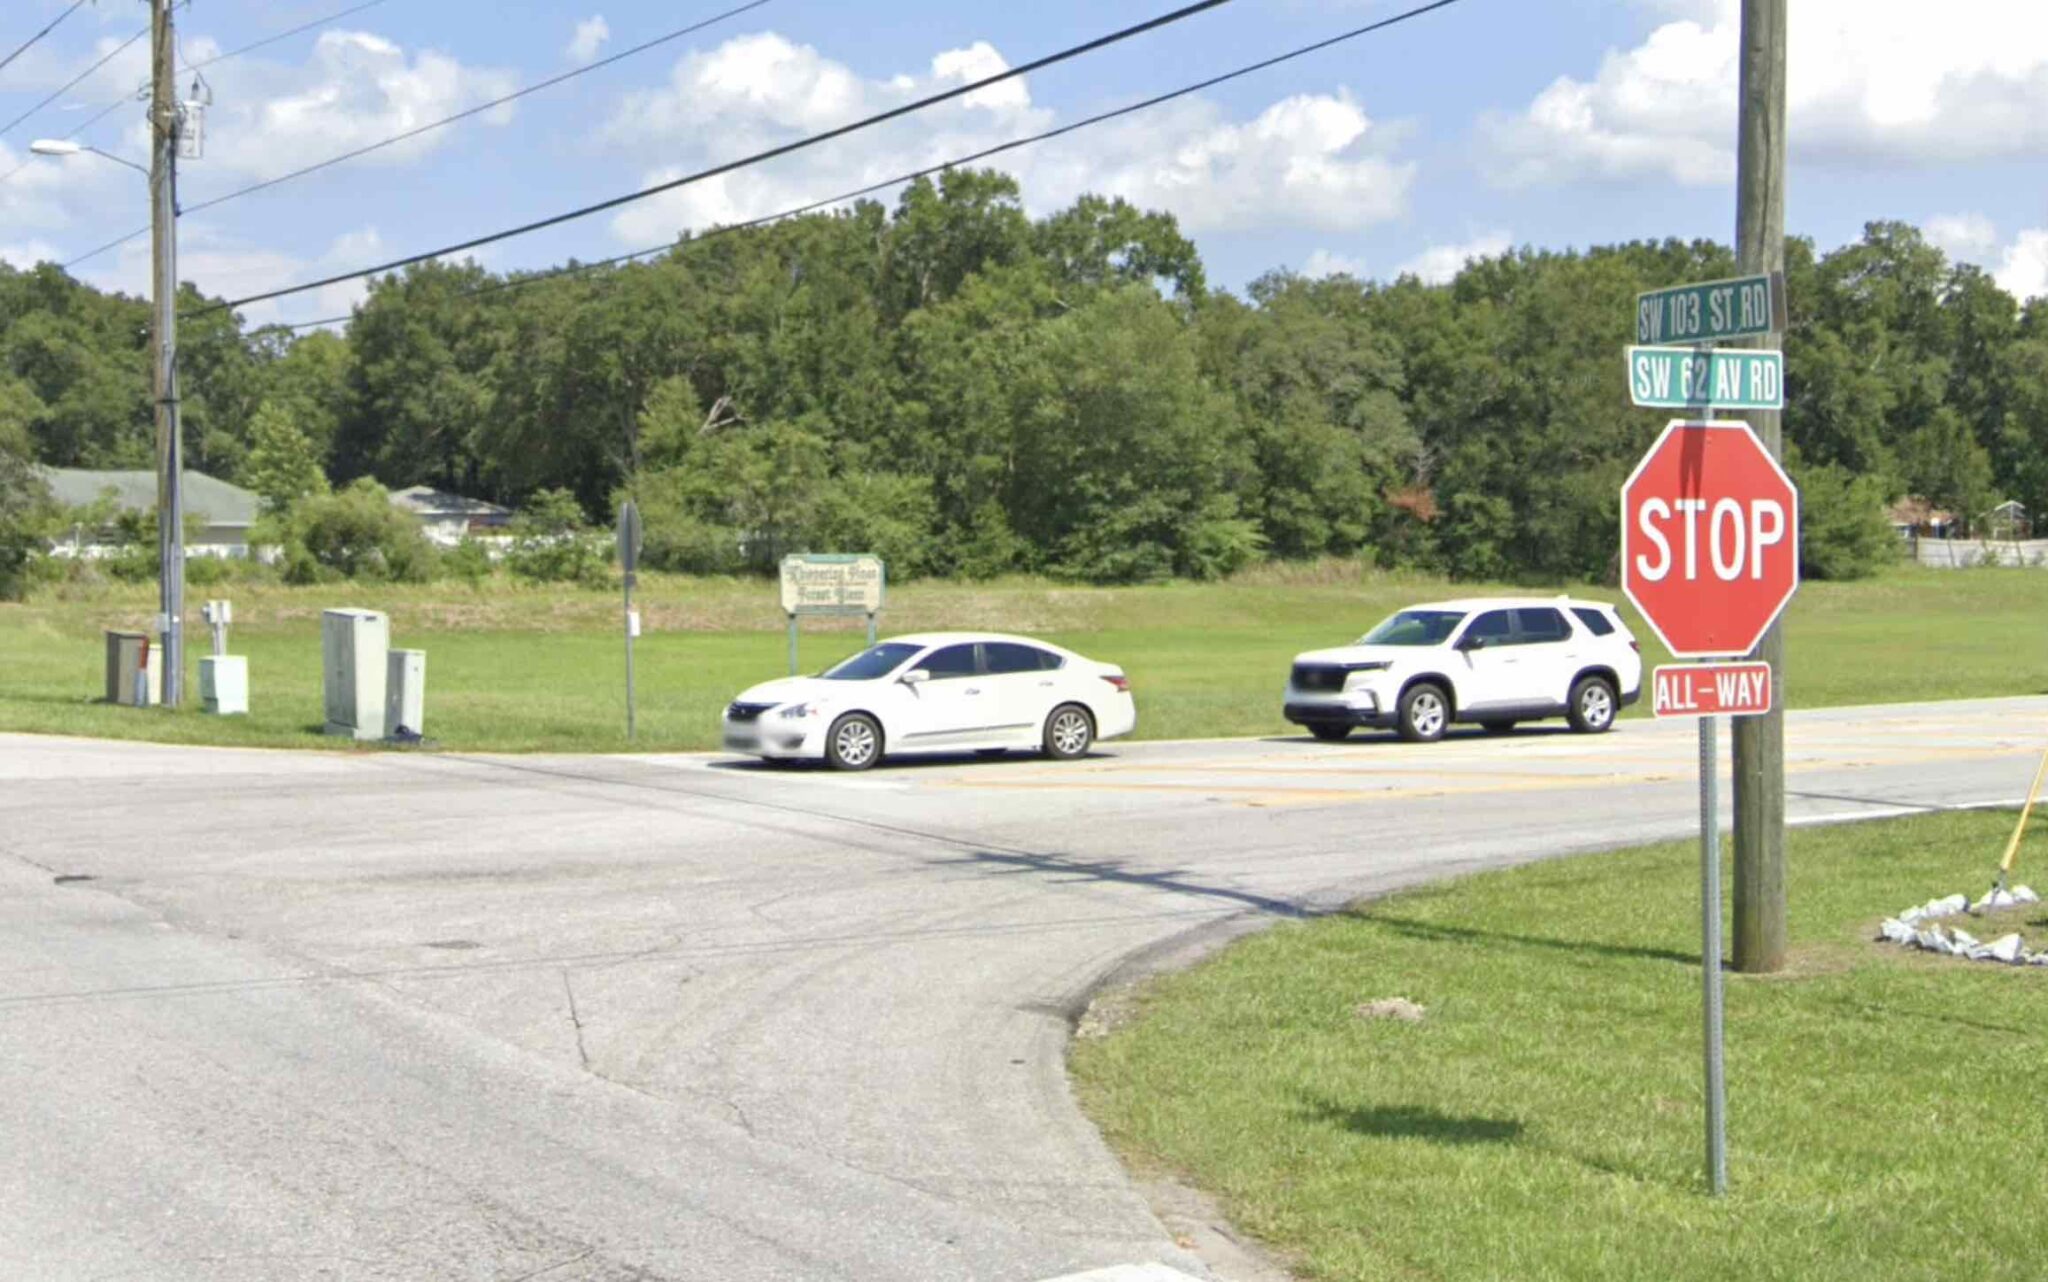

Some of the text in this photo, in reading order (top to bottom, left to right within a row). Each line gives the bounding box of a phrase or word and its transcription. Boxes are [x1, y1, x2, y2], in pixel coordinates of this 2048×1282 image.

[1640, 284, 1765, 341] SW 103 ST RD
[1637, 356, 1776, 401] SW 62 AV RD
[1636, 497, 1784, 581] STOP
[1656, 672, 1765, 711] ALL-WAY
